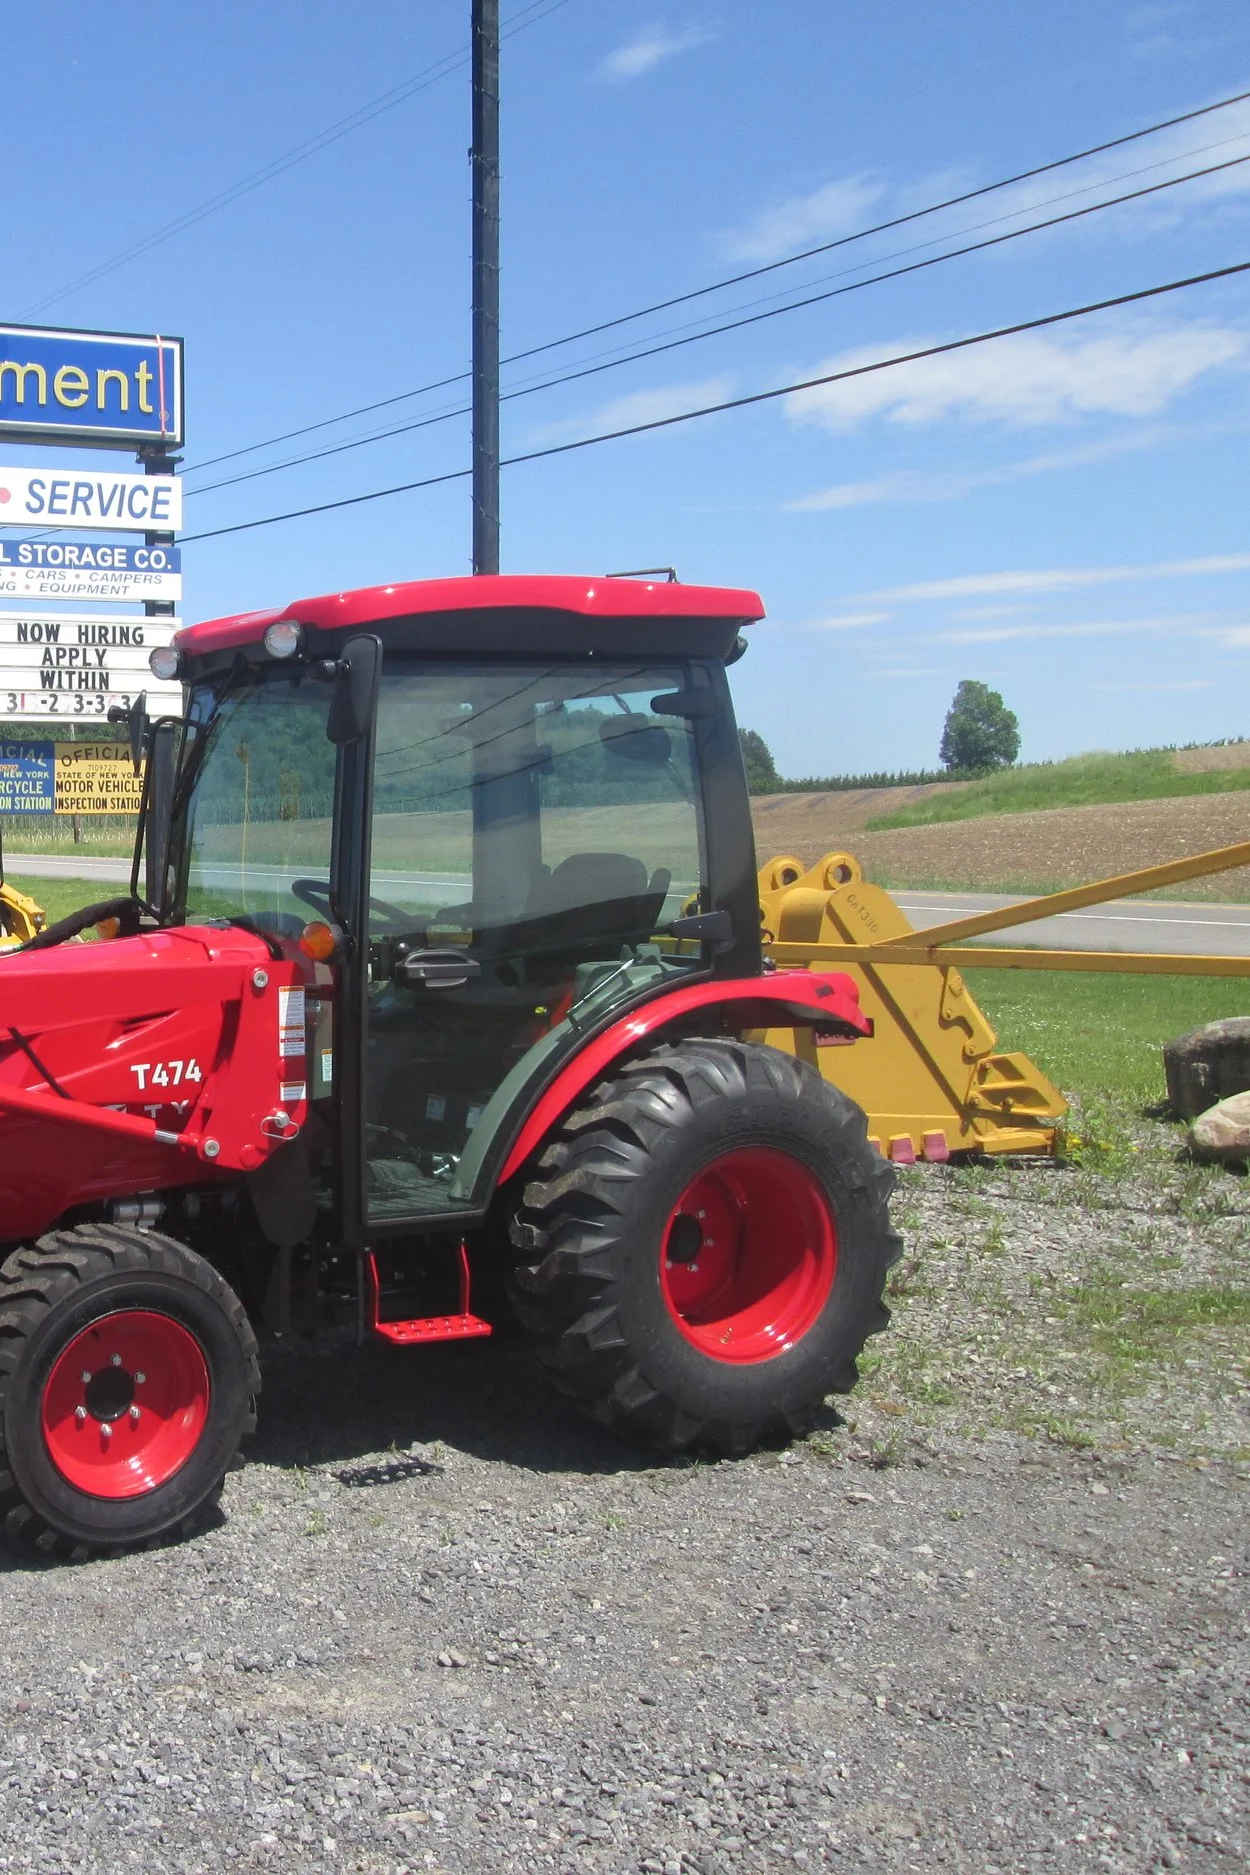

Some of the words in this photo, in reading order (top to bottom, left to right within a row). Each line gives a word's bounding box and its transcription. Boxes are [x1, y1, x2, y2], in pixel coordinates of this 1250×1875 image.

[25, 478, 172, 520] SERVICE
[18, 544, 127, 568] STORAGE
[134, 549, 171, 570] CO.
[25, 569, 67, 580] CARS
[89, 572, 163, 585] CAMPERS
[39, 583, 130, 596] EQUIPMENT
[17, 622, 61, 643] NOW
[77, 624, 144, 645] HIRING
[42, 647, 107, 667] APPLY
[40, 670, 110, 690] WITHIN
[61, 747, 131, 767] OFFICIA
[55, 780, 93, 793] MOTOR
[98, 780, 144, 793] VEHICLE
[14, 797, 52, 810] STATION
[55, 797, 107, 810] INSPECTION
[110, 797, 140, 810] STATIO
[130, 1059, 202, 1090] T474
[144, 1100, 189, 1118] TY
